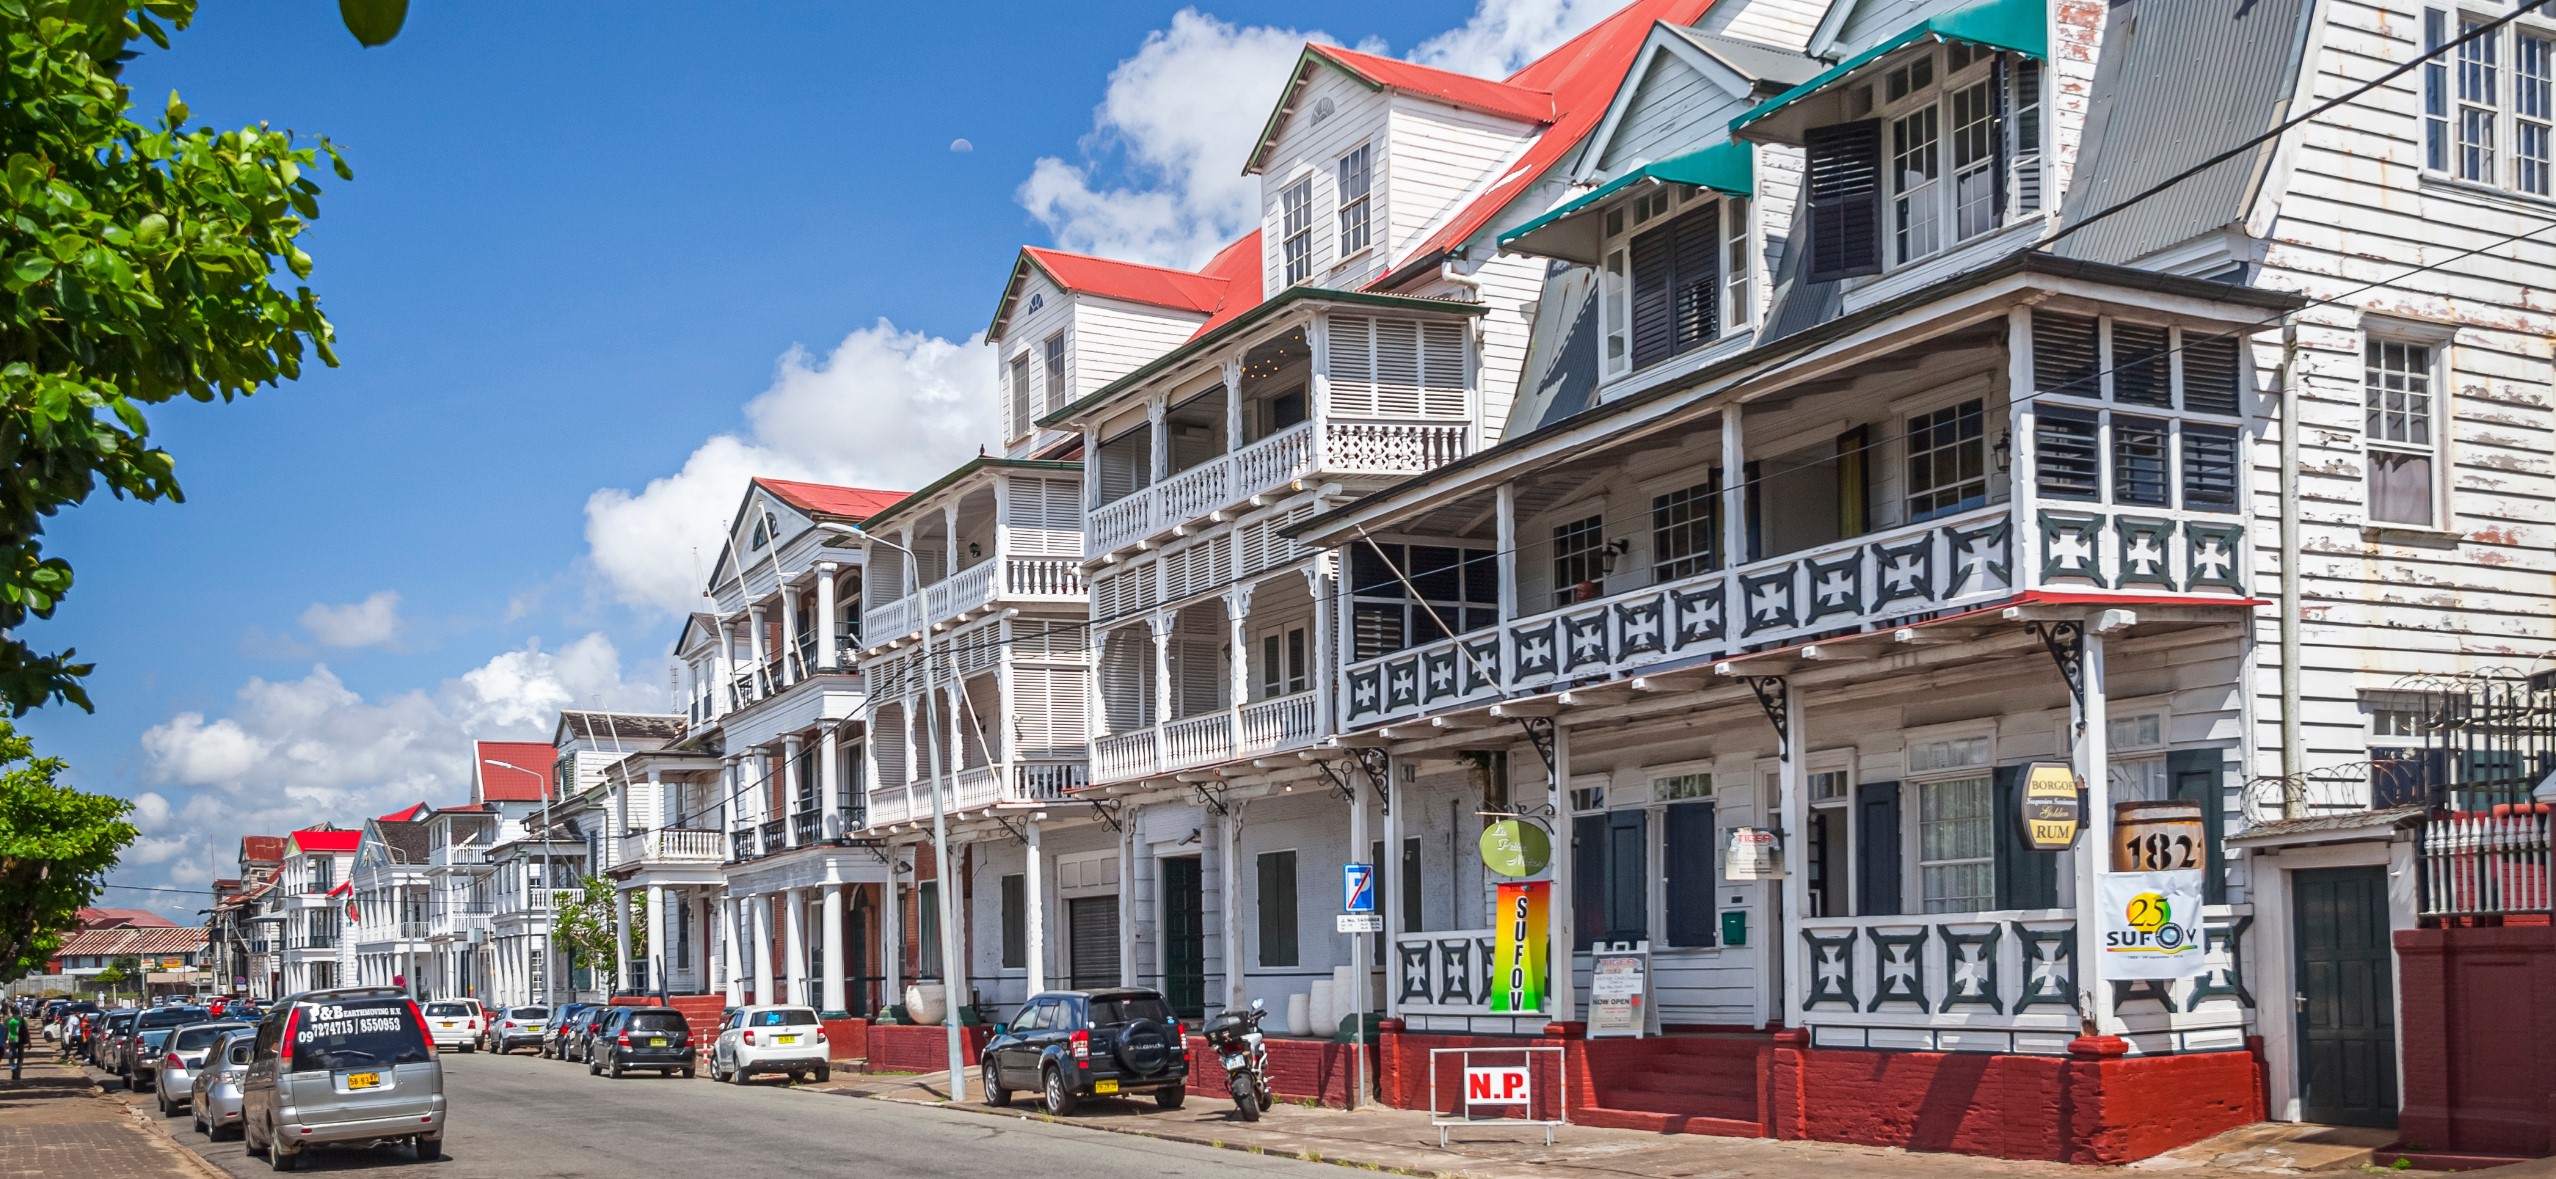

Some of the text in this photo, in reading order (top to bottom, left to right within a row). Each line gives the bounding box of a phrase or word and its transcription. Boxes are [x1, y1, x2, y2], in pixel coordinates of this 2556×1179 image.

[2032, 780, 2075, 791] BORGOE
[2039, 805, 2069, 819] Golden
[1737, 834, 1772, 842] TIGER
[2036, 825, 2070, 839] RUM
[1348, 872, 1371, 905] P
[2128, 897, 2169, 927] 25
[1509, 897, 1528, 1011] SUFOV
[343, 1007, 389, 1017] EARTHMOVING
[1470, 1073, 1526, 1098] N.P.
